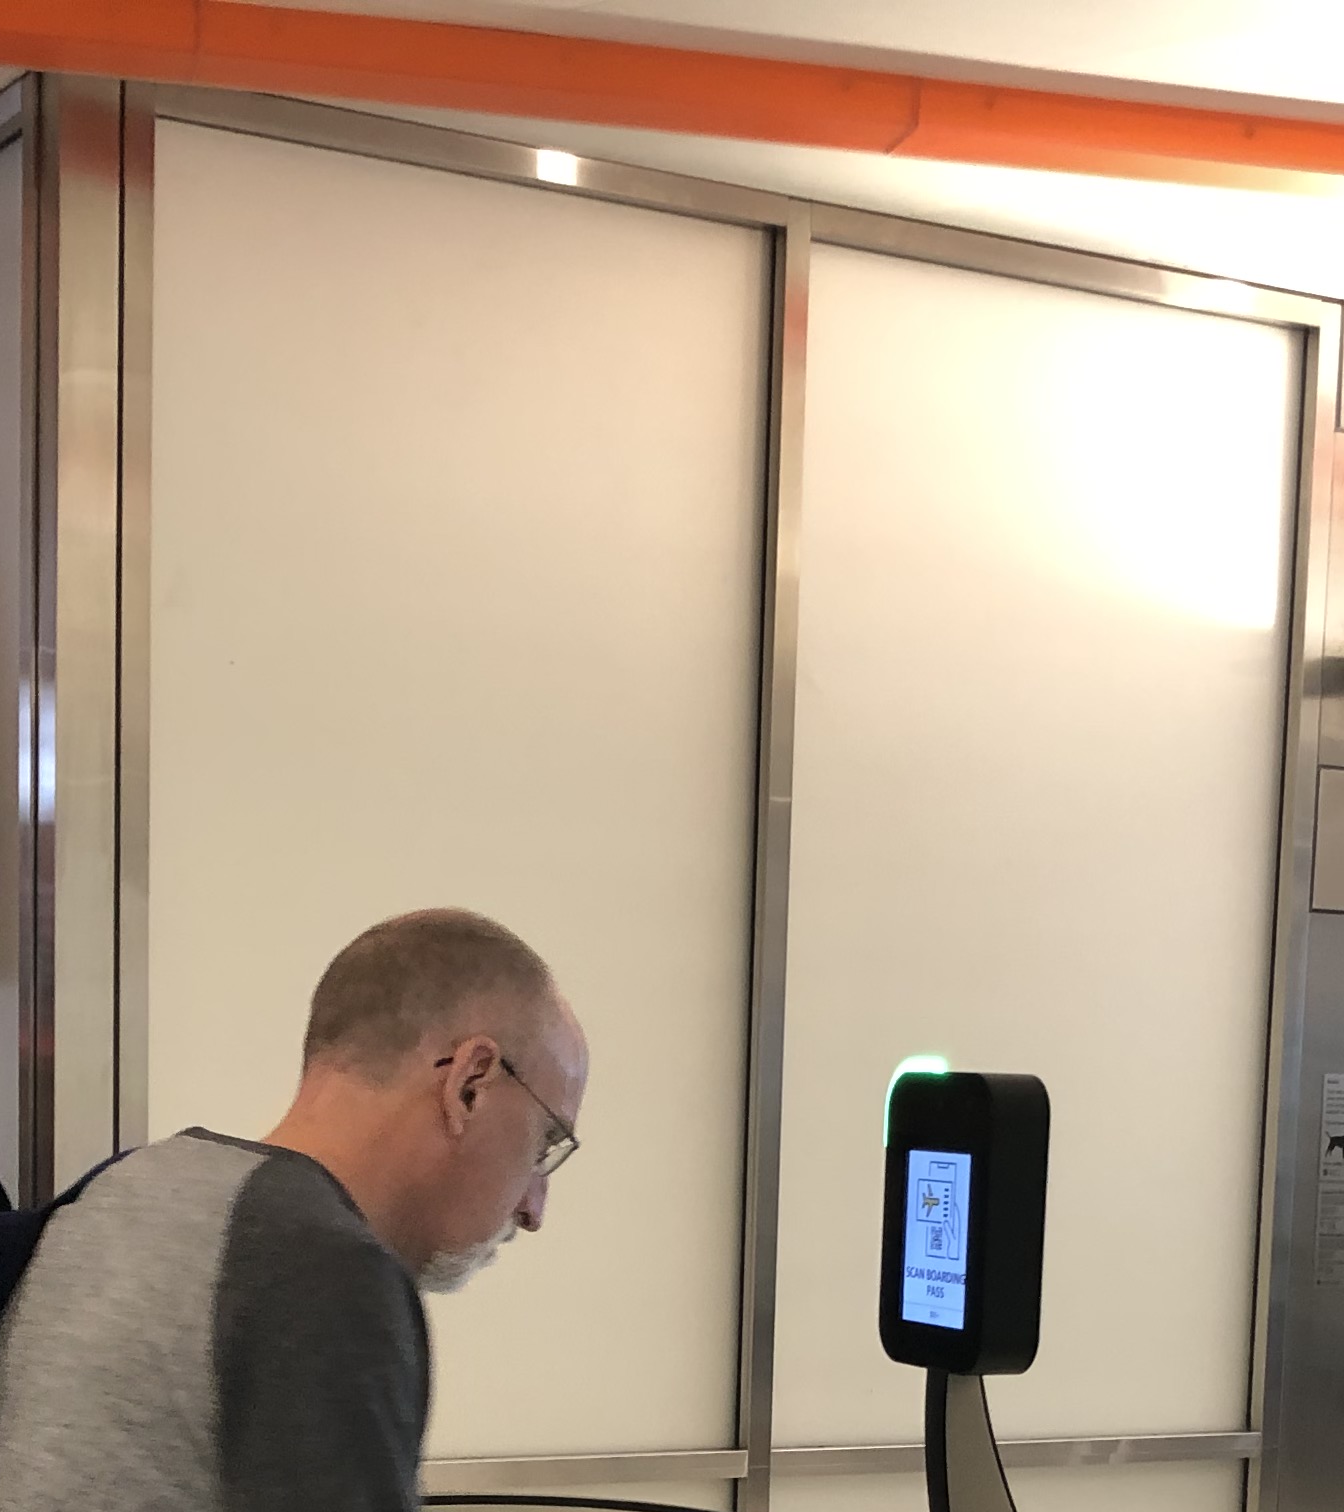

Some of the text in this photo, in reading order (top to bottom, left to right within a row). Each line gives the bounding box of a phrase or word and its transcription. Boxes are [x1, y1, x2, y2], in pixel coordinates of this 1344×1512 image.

[906, 1265, 966, 1299] SCAN BOARDING PASS
